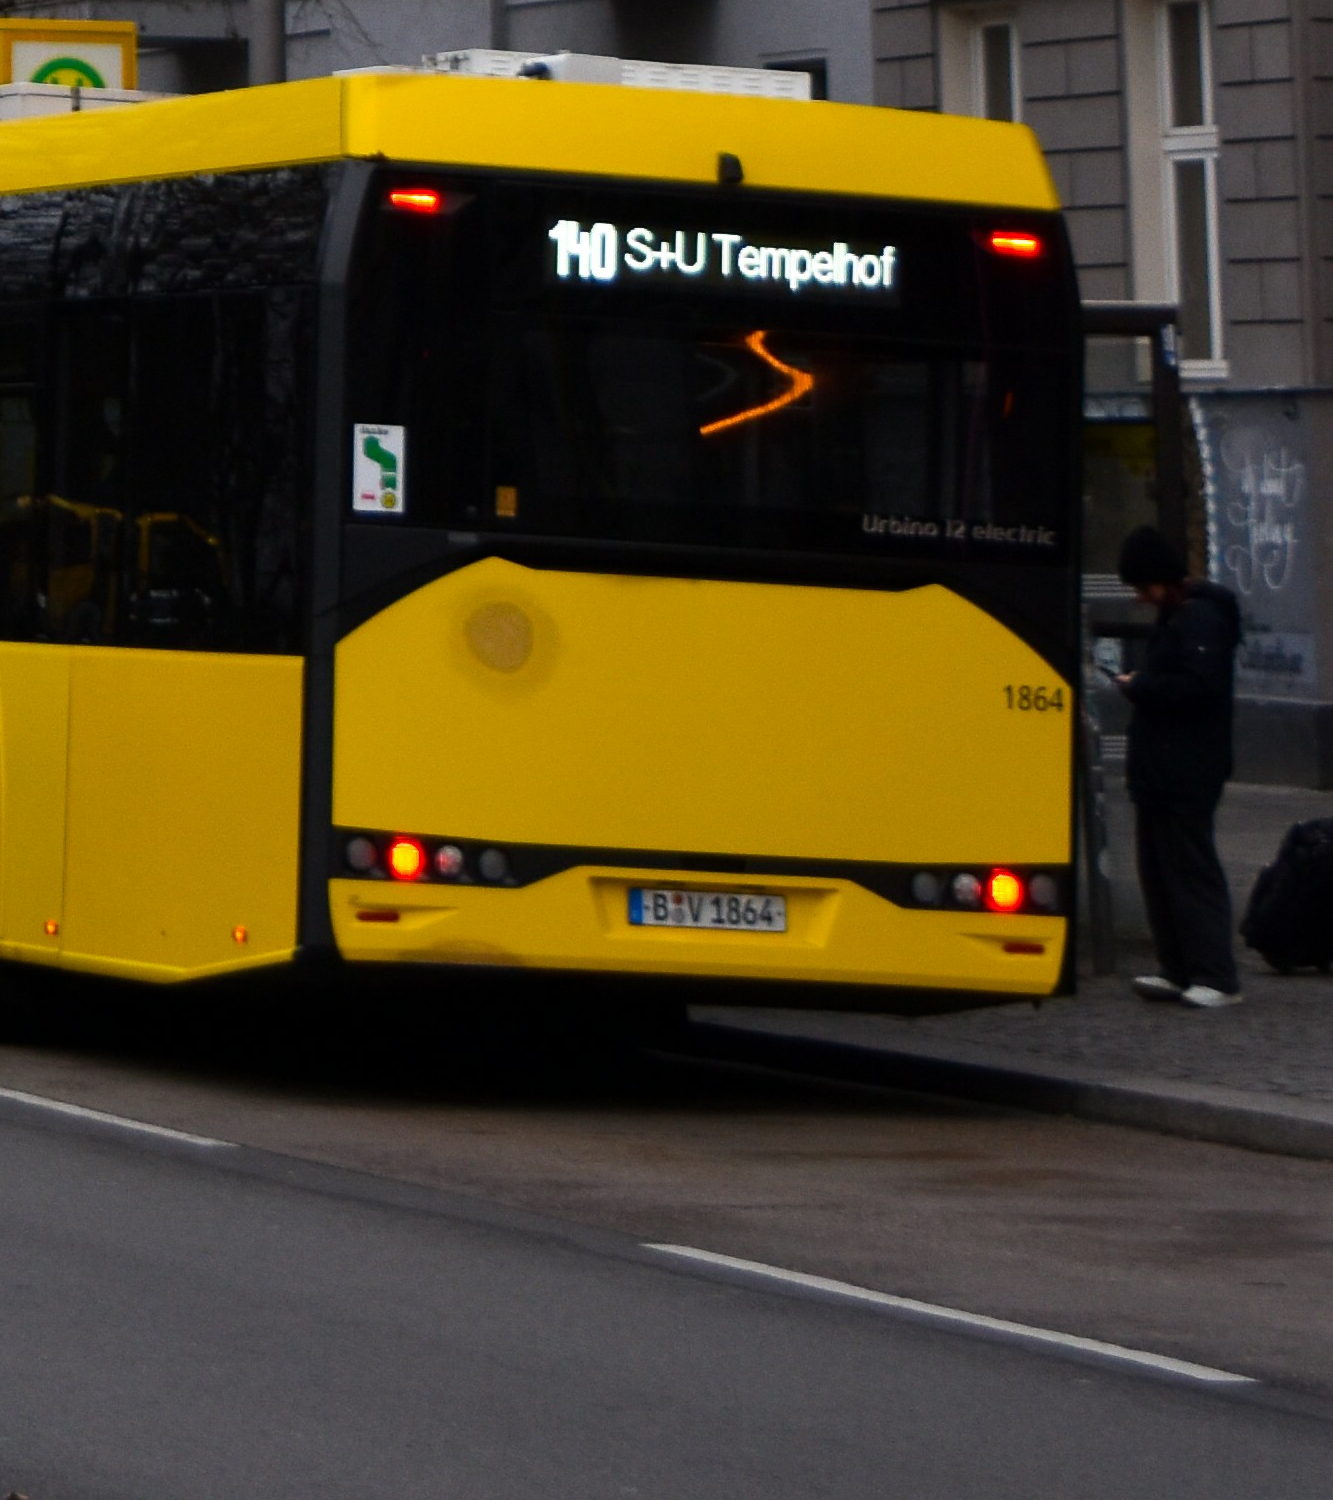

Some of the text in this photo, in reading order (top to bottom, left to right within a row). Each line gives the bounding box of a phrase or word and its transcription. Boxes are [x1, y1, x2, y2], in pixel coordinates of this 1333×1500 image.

[548, 219, 895, 292] 140 S+U Tempelhof
[862, 513, 1057, 546] Urbino 12 electric
[1003, 684, 1064, 713] 1864
